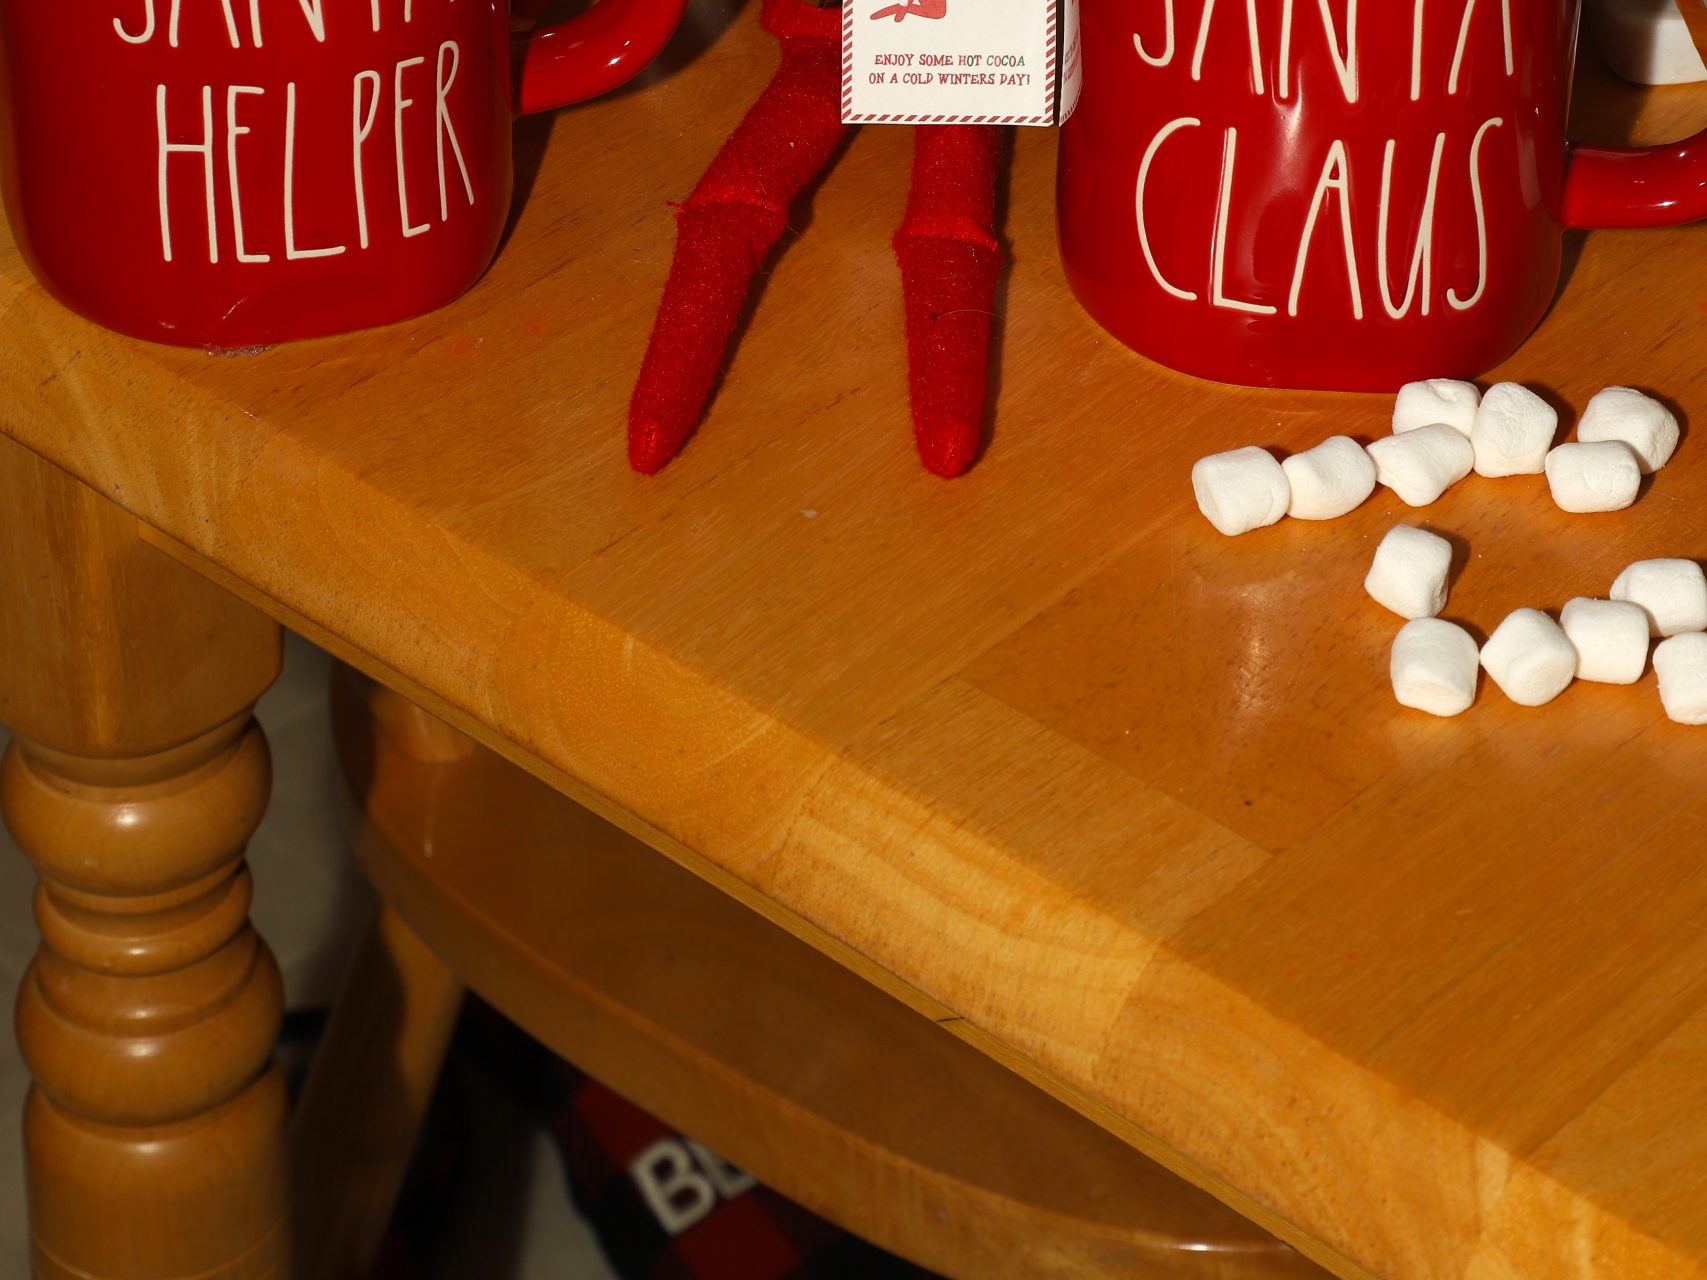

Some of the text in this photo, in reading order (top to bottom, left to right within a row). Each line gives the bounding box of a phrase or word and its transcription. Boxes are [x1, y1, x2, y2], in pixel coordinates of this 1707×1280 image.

[868, 72, 1031, 86] ON A COLD WINTERS DAY!
[874, 53, 1026, 67] ENJOY SOME HOT COCOA
[156, 39, 475, 264] HELPER
[1135, 116, 1503, 320] CLAUS
